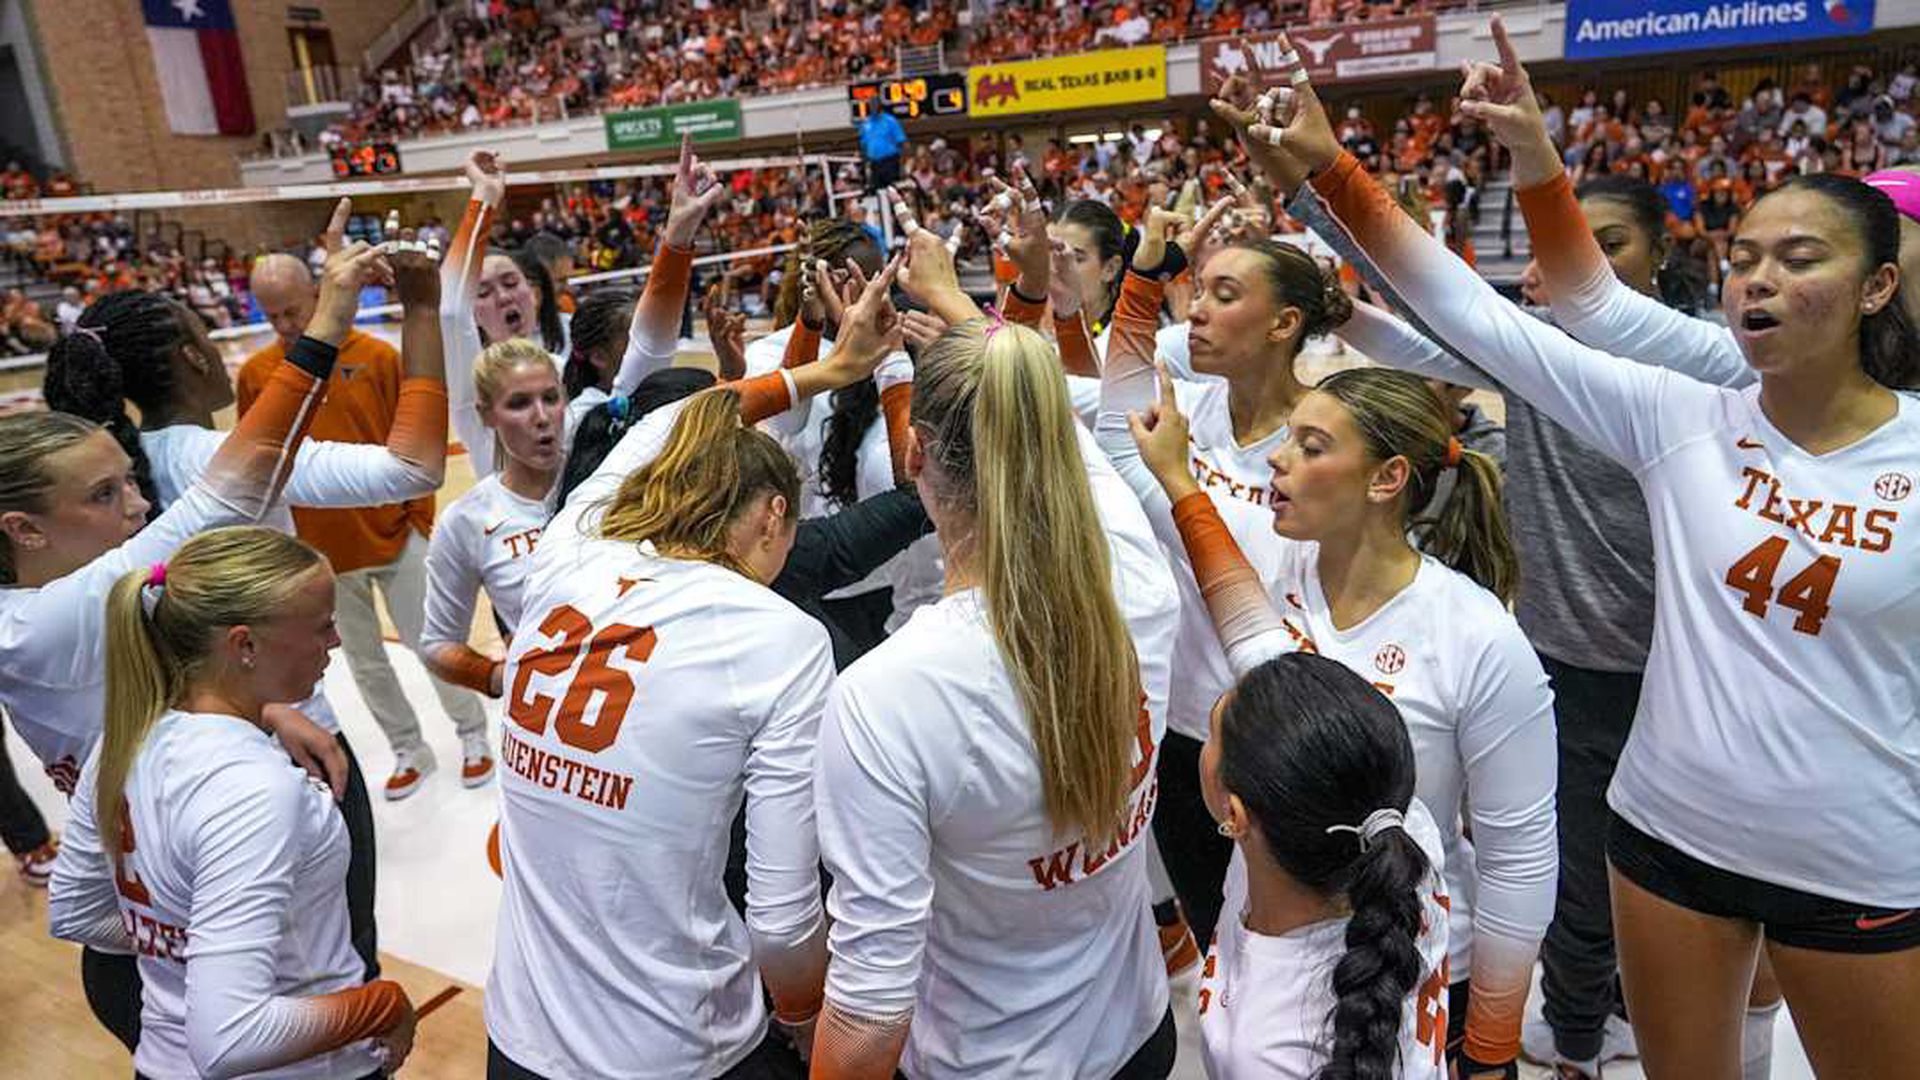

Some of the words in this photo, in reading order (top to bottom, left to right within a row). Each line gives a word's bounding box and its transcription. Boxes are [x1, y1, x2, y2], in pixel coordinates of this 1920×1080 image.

[1576, 14, 1700, 42] American
[1702, 1, 1807, 29] Airlines
[1024, 79, 1056, 91] REAL
[1059, 72, 1099, 89] TEXAS
[1874, 473, 1911, 501] SEC
[1735, 466, 1898, 552] TEXAS
[1725, 535, 1842, 636] 44
[509, 604, 658, 753] 26
[1374, 644, 1406, 674] SEC
